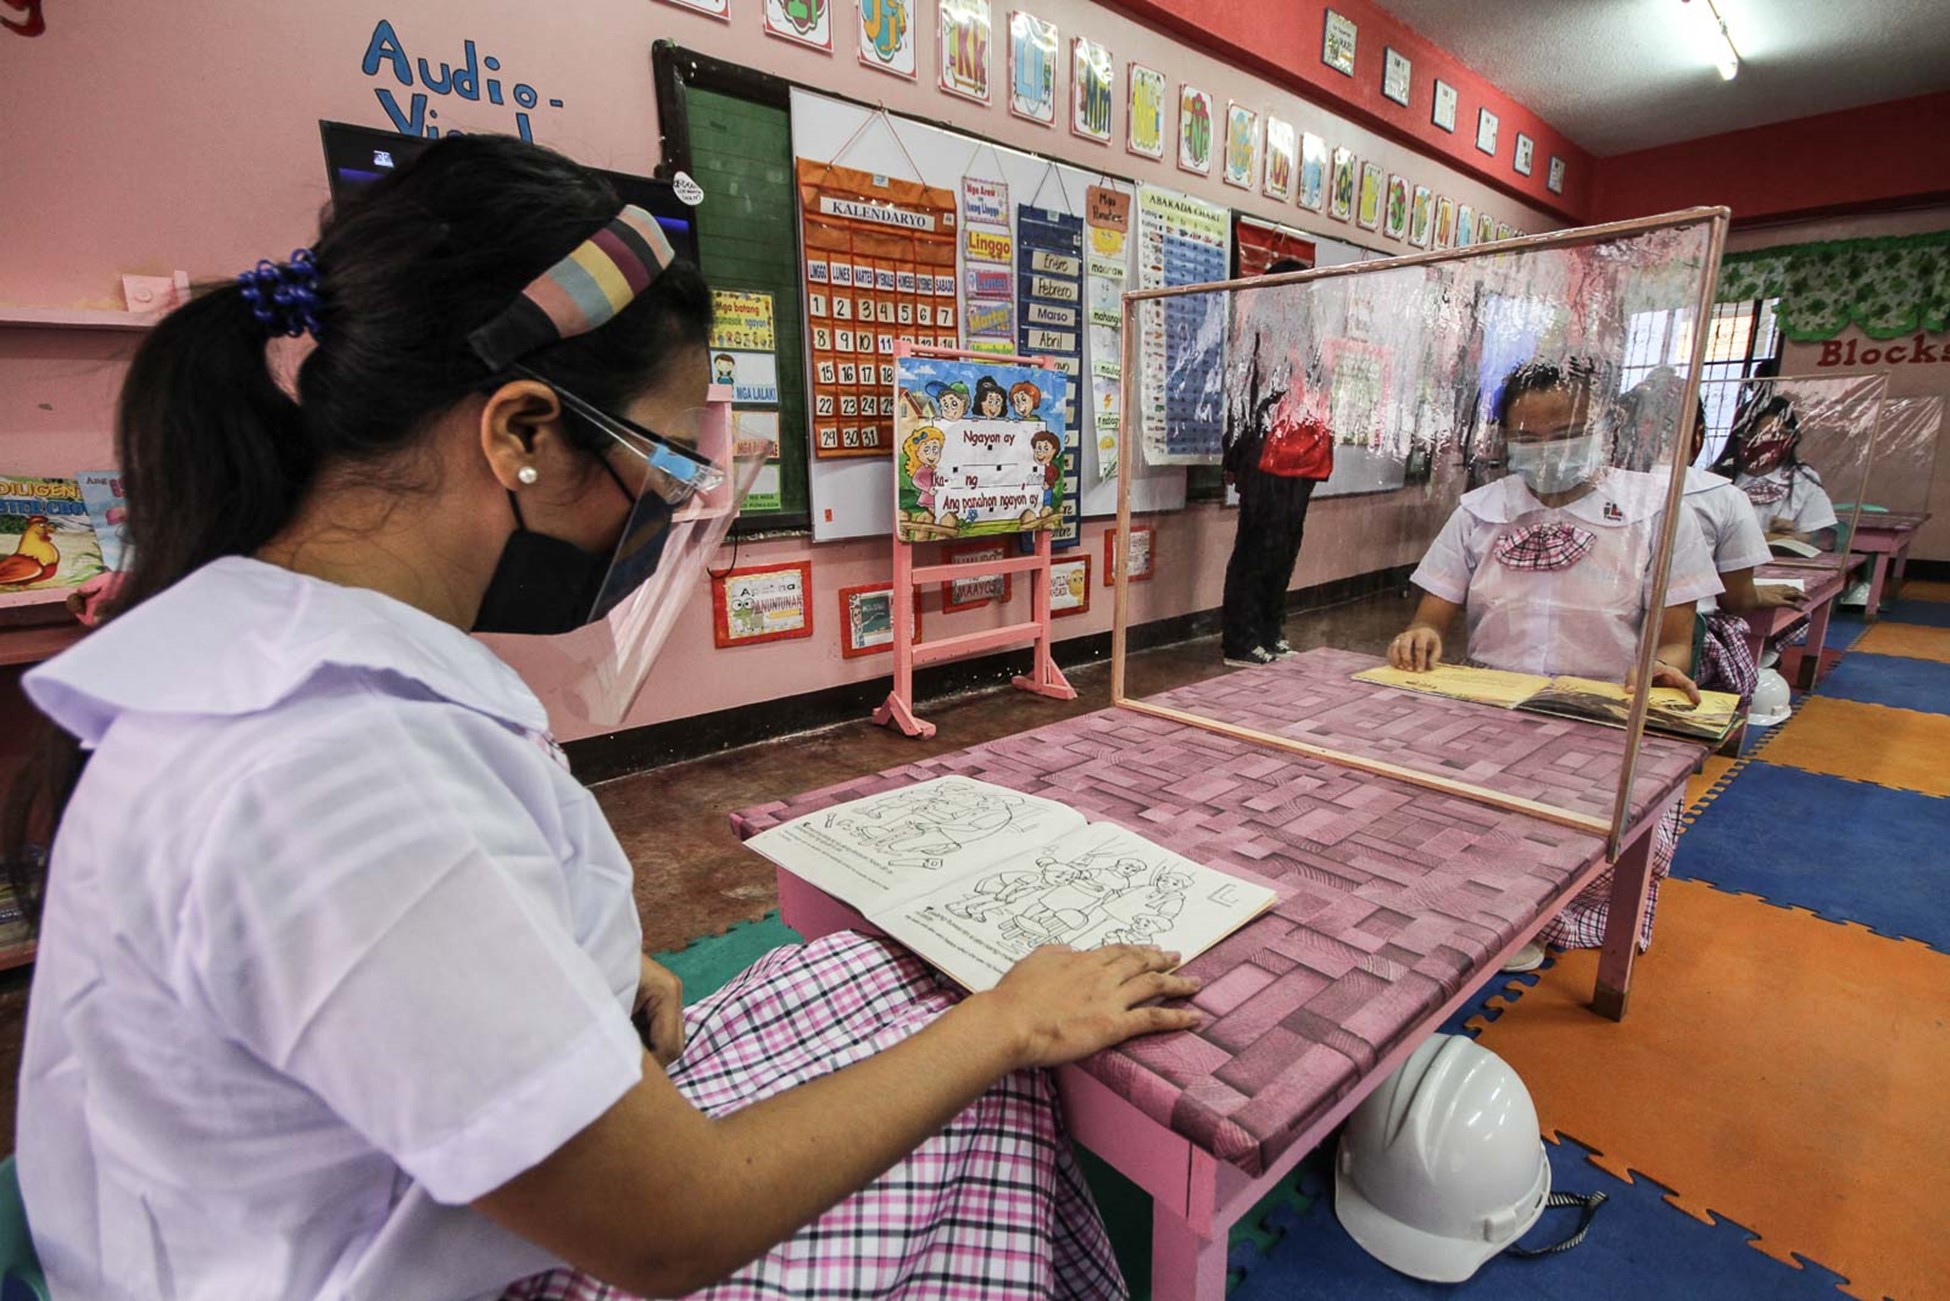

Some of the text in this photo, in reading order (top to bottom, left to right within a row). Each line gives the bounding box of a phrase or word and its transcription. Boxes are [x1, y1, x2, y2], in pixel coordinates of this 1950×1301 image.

[362, 19, 564, 109] Audio-
[1149, 195, 1192, 214] ABAKADA
[832, 201, 926, 227] KALENDARYO
[968, 231, 1011, 258] Linggo
[832, 265, 851, 281] LUNES
[813, 296, 949, 324] 1 2 3 4 5 6 7
[1037, 308, 1068, 322] Marso
[816, 329, 826, 347] 8
[841, 332, 849, 349] 9
[859, 334, 871, 349] 10
[880, 338, 892, 350] 11
[1039, 332, 1063, 349] Abril
[1817, 333, 1950, 368] Blocks
[820, 366, 893, 383] 15 16 17 18
[819, 398, 832, 413] 22
[843, 399, 856, 414] 23
[861, 397, 875, 413] 24
[822, 429, 876, 446] 29 30 31
[963, 430, 1015, 446] Ngayon ay
[0, 482, 80, 497] DILIGEN
[965, 475, 978, 489] ng
[943, 492, 1039, 514] Ang panahon ngayon ay
